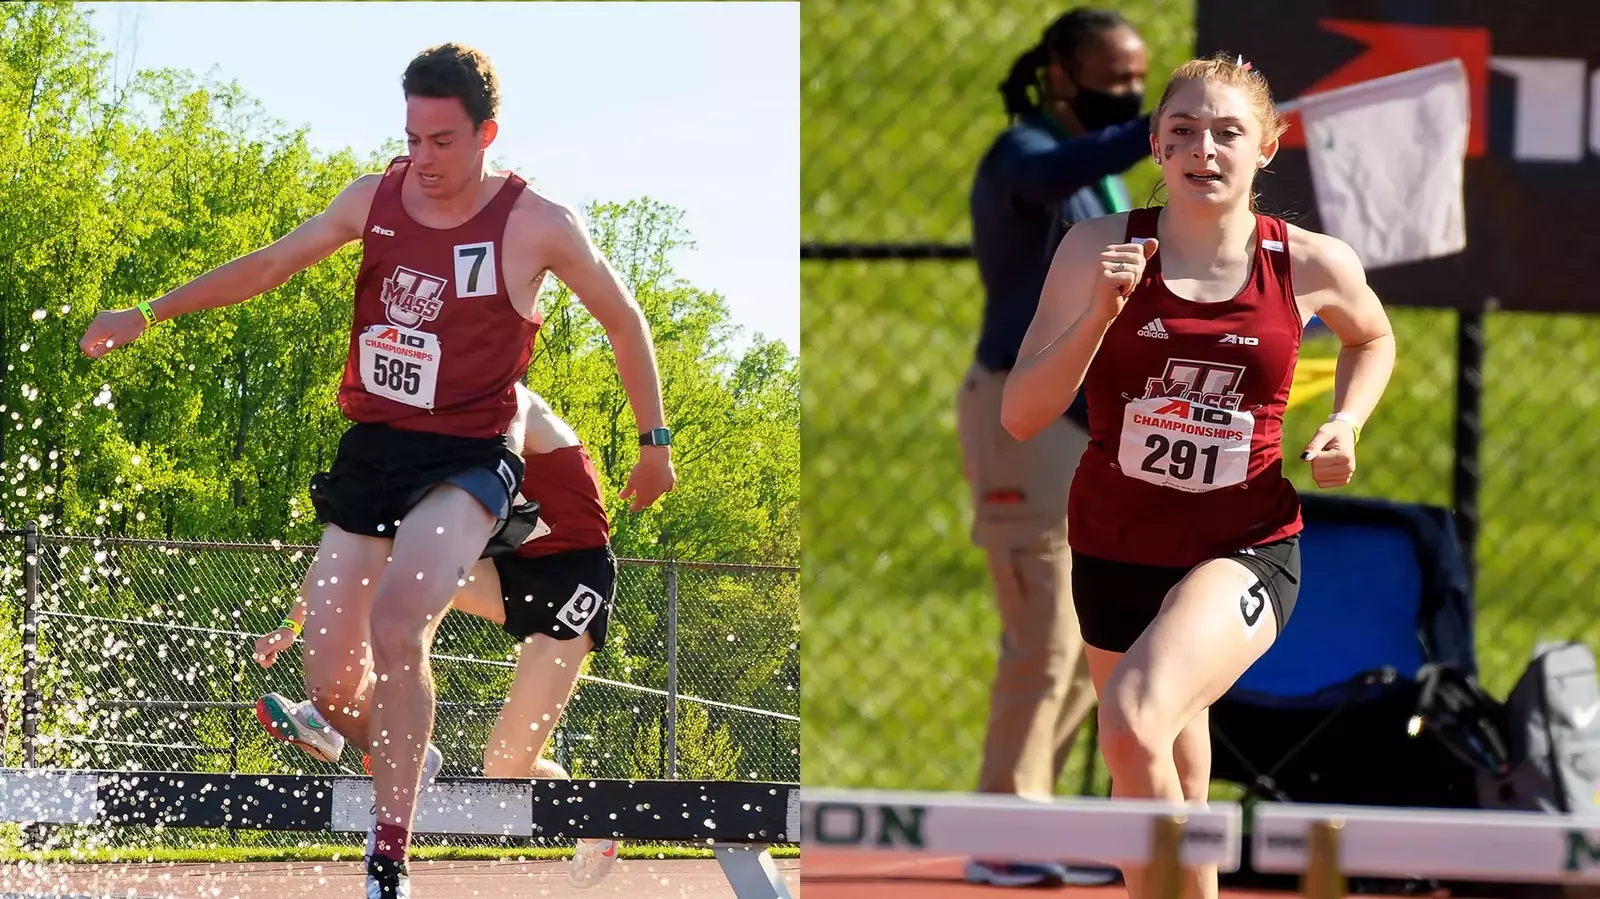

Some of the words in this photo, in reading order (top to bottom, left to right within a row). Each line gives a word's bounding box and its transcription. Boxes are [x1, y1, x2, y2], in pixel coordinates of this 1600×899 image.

[371, 225, 395, 237] A10
[458, 246, 487, 293] 7
[377, 326, 426, 349] A10
[1137, 329, 1169, 340] adidas
[1218, 333, 1259, 346] A10
[365, 339, 434, 362] CHAMPIONSHIPS
[373, 353, 422, 396] 585
[1152, 398, 1233, 426] A10
[1133, 414, 1244, 441] CHAMPIONSHIPS
[1140, 433, 1220, 485] 291
[565, 591, 597, 627] 9
[1239, 579, 1265, 627] 5
[801, 801, 928, 848] ON
